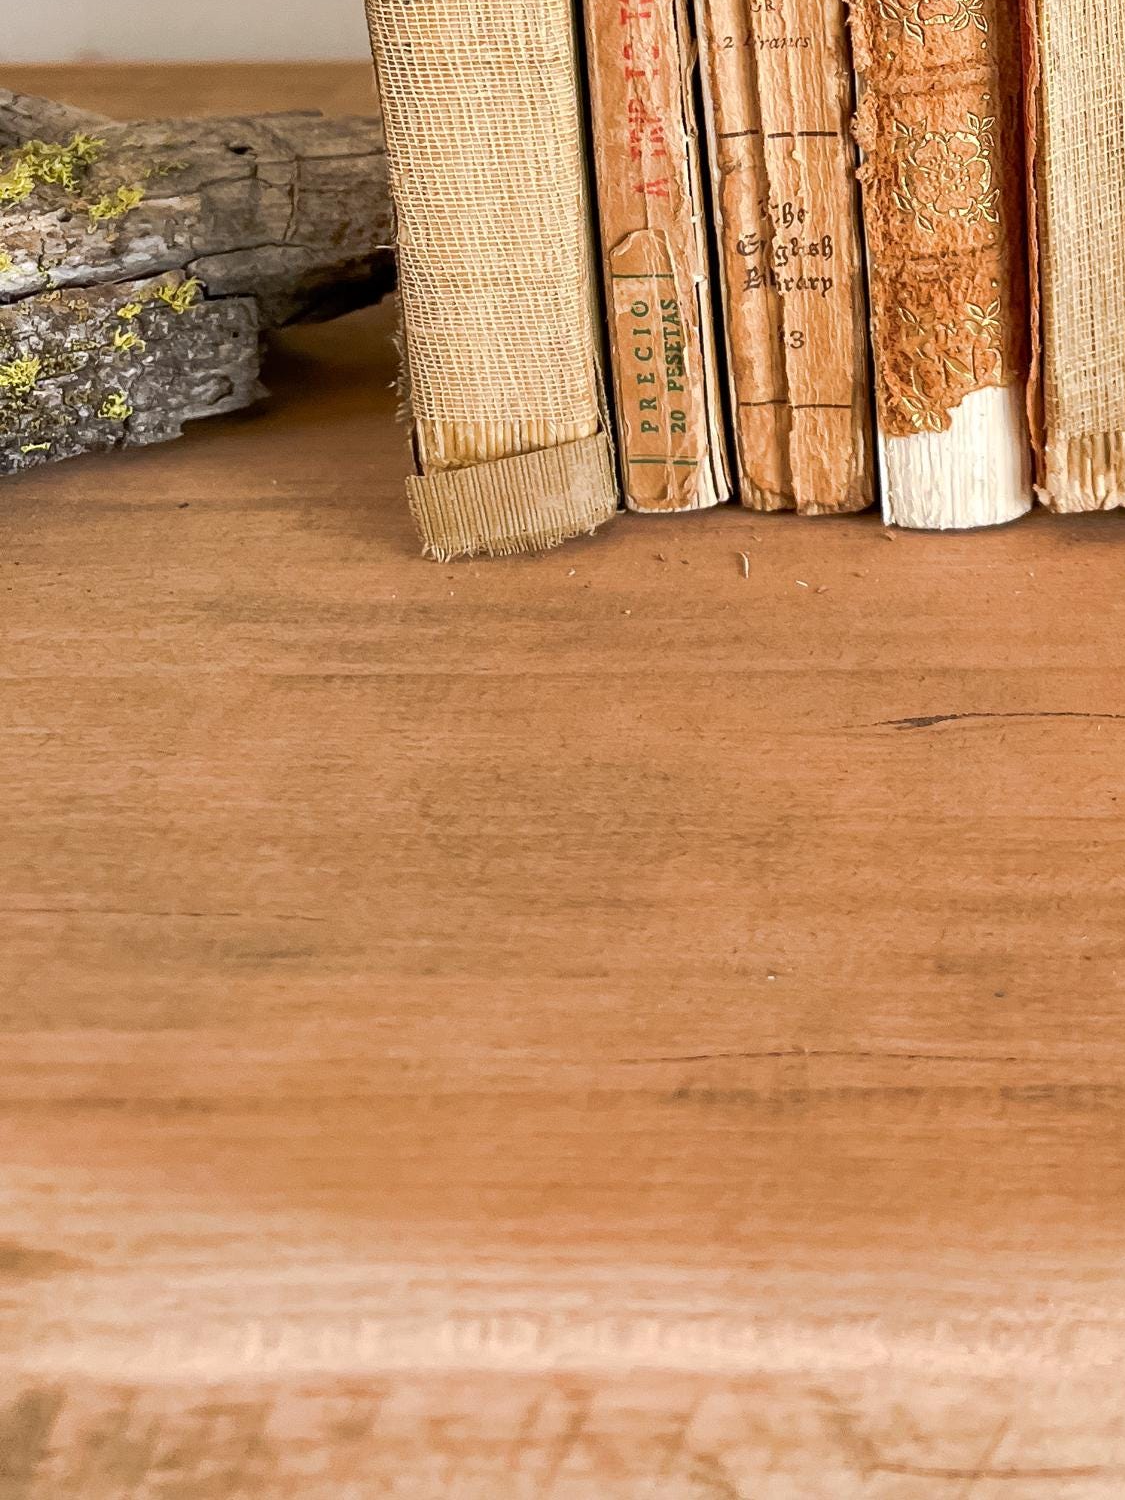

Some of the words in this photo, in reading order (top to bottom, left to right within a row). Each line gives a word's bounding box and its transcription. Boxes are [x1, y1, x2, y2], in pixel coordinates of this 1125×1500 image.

[723, 36, 735, 49] 2
[630, 300, 659, 434] PRECIO
[660, 298, 686, 393] PESETAS
[669, 410, 687, 434] 20
